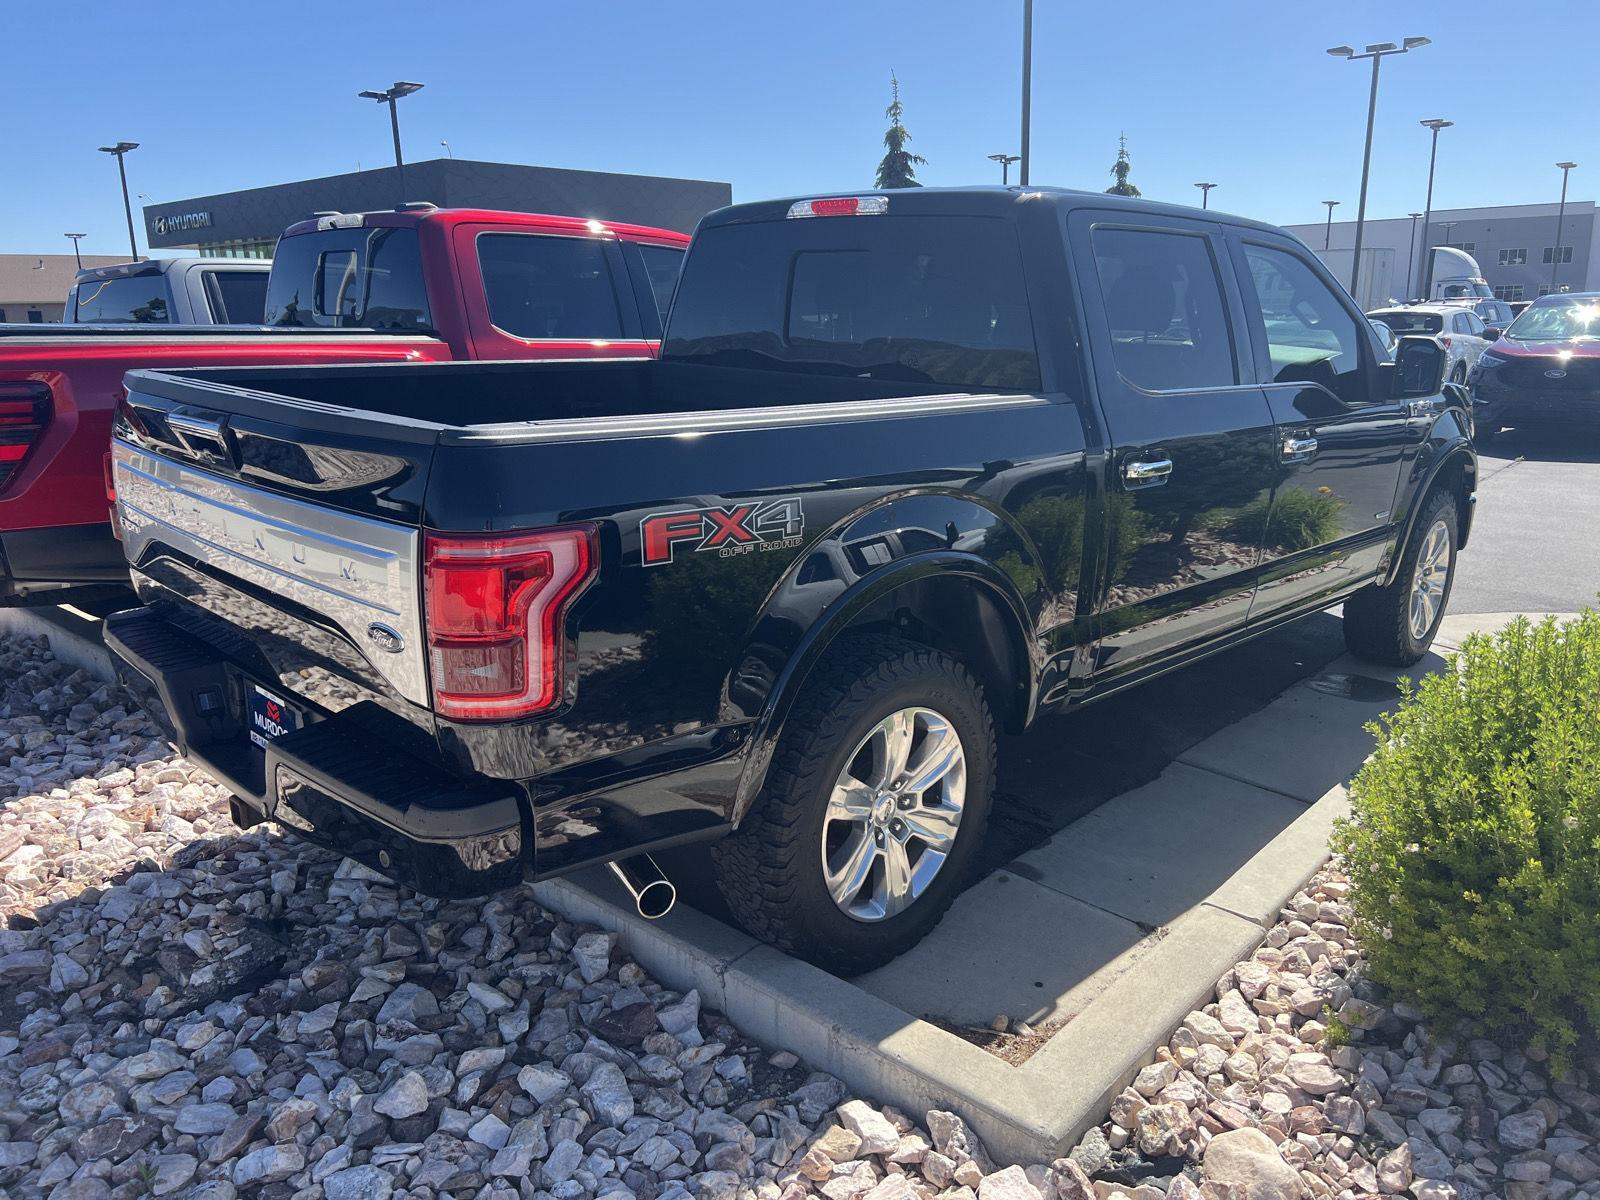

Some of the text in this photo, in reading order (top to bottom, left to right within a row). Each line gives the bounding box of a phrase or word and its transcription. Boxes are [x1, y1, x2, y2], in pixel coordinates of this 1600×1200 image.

[168, 211, 210, 231] HYUNDAI
[639, 496, 805, 568] FX4
[719, 537, 804, 558] OFF ROAD
[254, 710, 289, 737] MURDO
